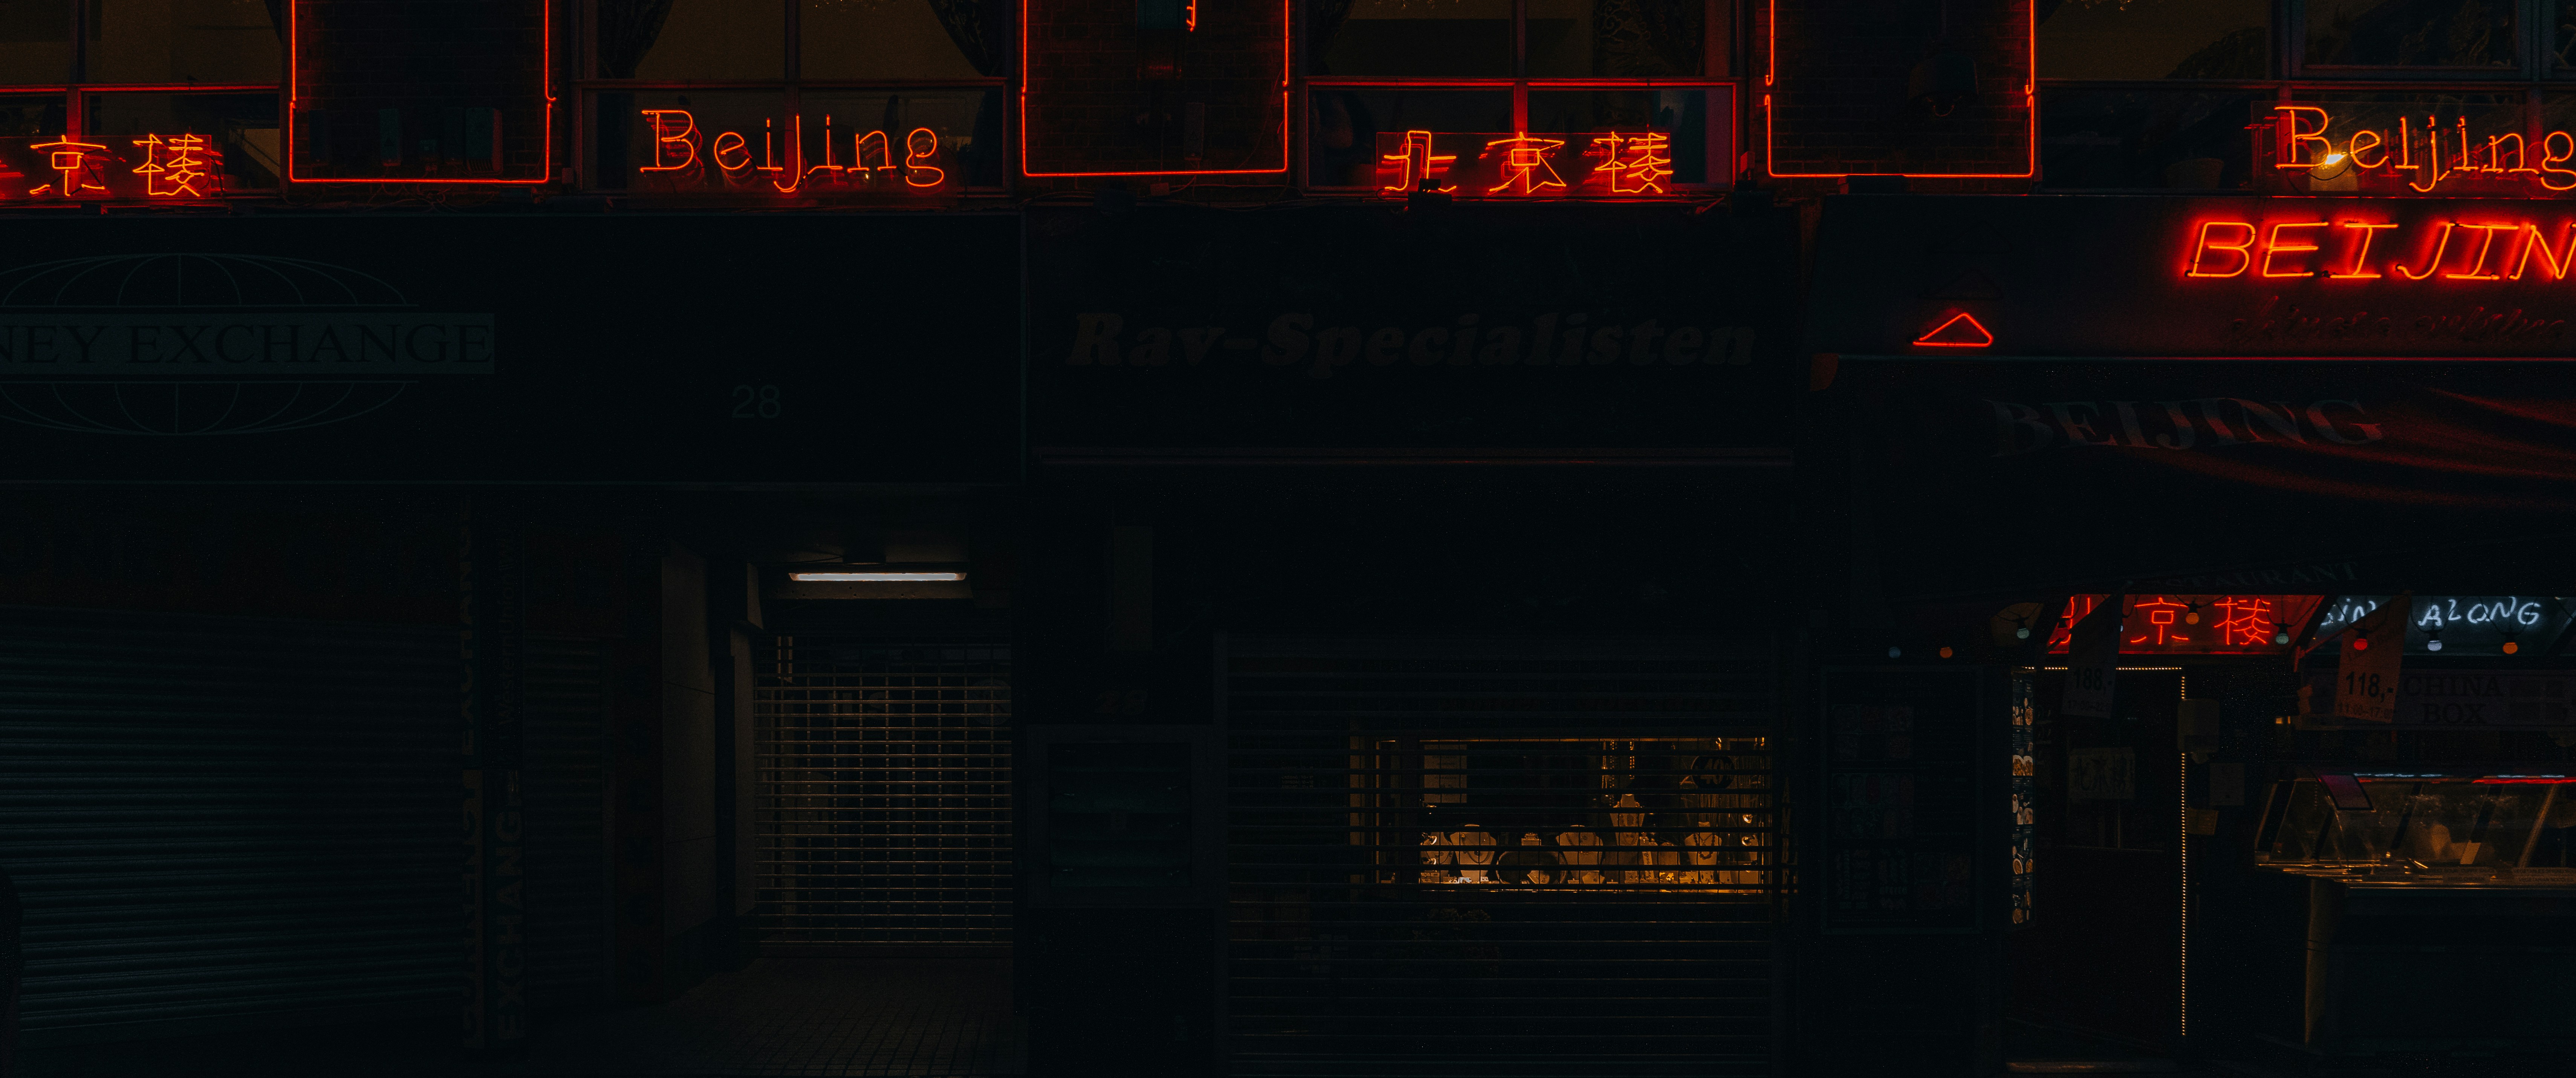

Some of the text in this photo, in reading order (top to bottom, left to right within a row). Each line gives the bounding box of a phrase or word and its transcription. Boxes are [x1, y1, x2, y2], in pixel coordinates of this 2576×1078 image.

[127, 323, 493, 364] EXCHANGE
[1065, 312, 1756, 380] Rav-Specialisten
[731, 384, 782, 419] 28
[1983, 397, 2383, 459] BEIJING
[2345, 671, 2394, 703] 118,-
[2403, 675, 2503, 697] CHINA
[2423, 703, 2487, 724] BOX
